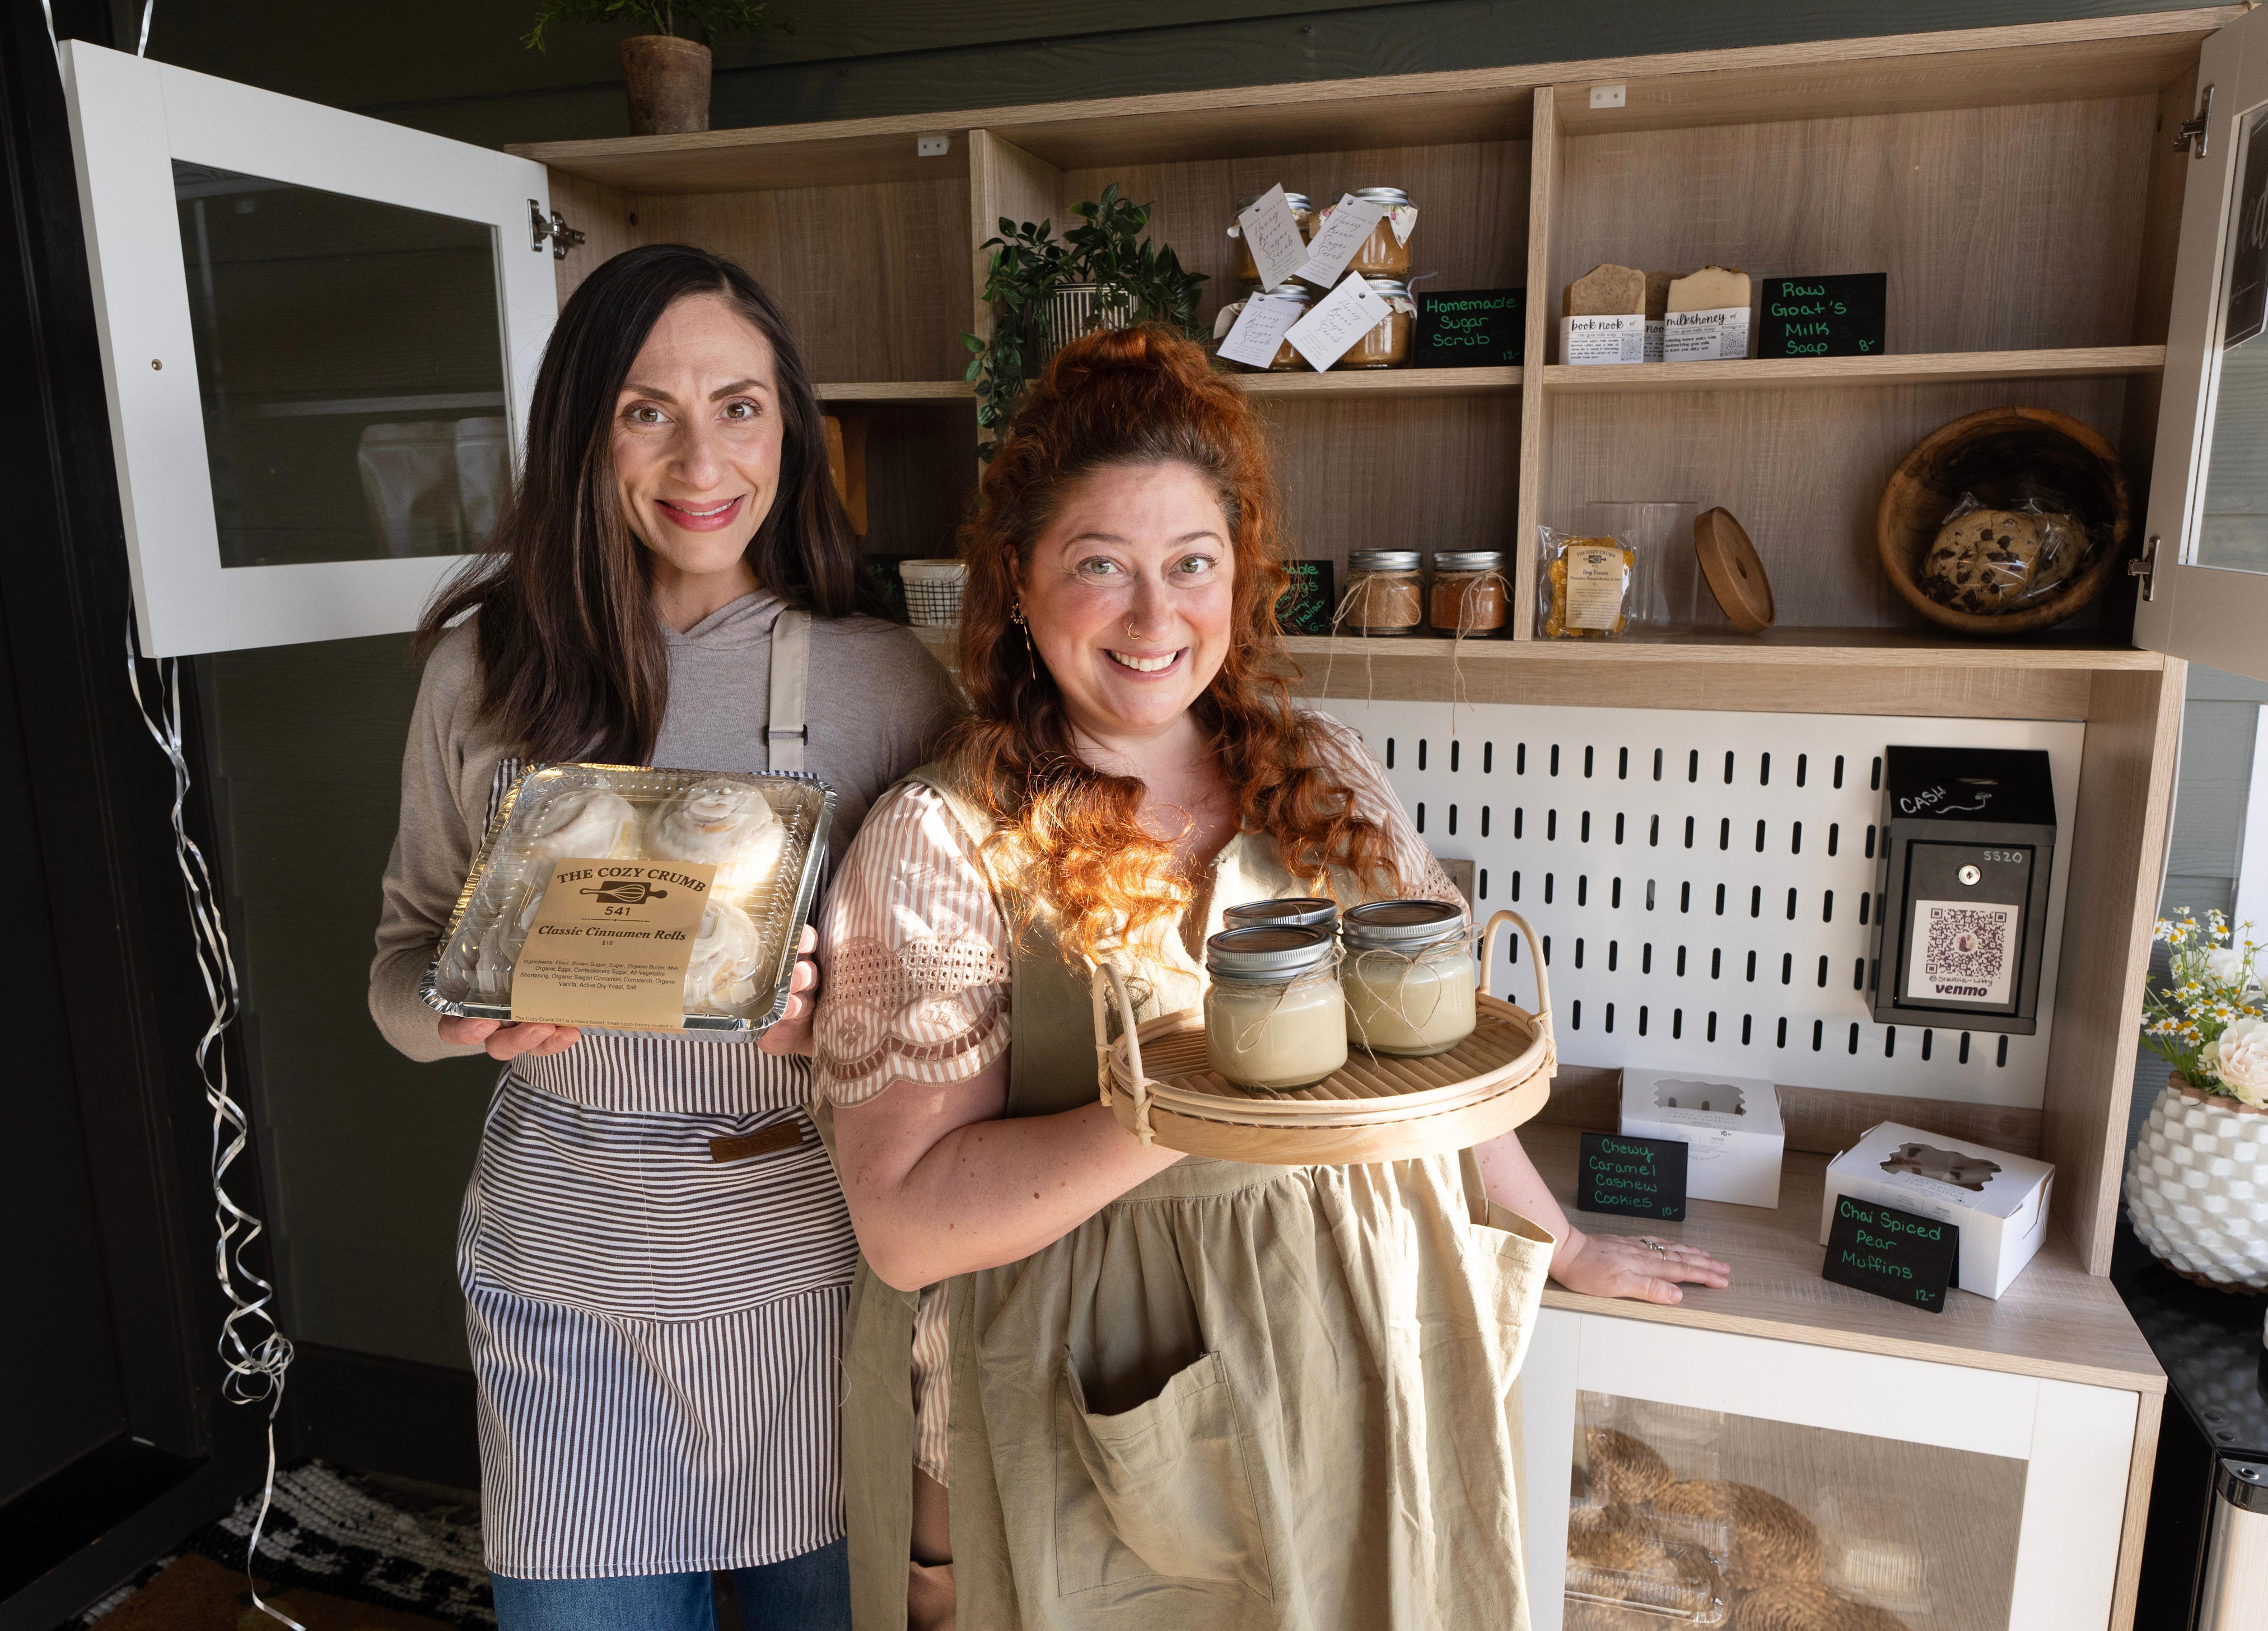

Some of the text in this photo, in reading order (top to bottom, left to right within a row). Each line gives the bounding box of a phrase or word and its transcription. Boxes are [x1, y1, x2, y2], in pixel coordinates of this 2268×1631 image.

[1782, 282, 1825, 297] Raw
[1426, 296, 1518, 313] Homemade
[1771, 301, 1847, 317] Goat's
[1440, 316, 1489, 333] Sugar
[1571, 318, 1624, 331] book nook
[1667, 314, 1726, 326] milk&honey
[1646, 325, 1664, 333] noo
[1785, 323, 1830, 336] Milk
[1432, 333, 1490, 347] Scrub
[1786, 340, 1828, 355] Soap
[1295, 600, 1324, 626] Italian
[1900, 786, 1946, 813] CASH
[557, 867, 706, 892] THE COZY CRUMB
[604, 906, 631, 916] 541
[538, 925, 686, 941] Classic Cinnamon Rolls
[1935, 984, 1988, 997] venmo
[1602, 1138, 1655, 1163] Chewy
[1589, 1156, 1656, 1176] Caramel
[1596, 1174, 1658, 1192] Cashew
[1594, 1190, 1653, 1208] Cookies
[1840, 1200, 1873, 1223] Chai
[1880, 1212, 1941, 1241] Spiced
[1856, 1230, 1897, 1250] Pear
[1842, 1250, 1913, 1279] Muffins
